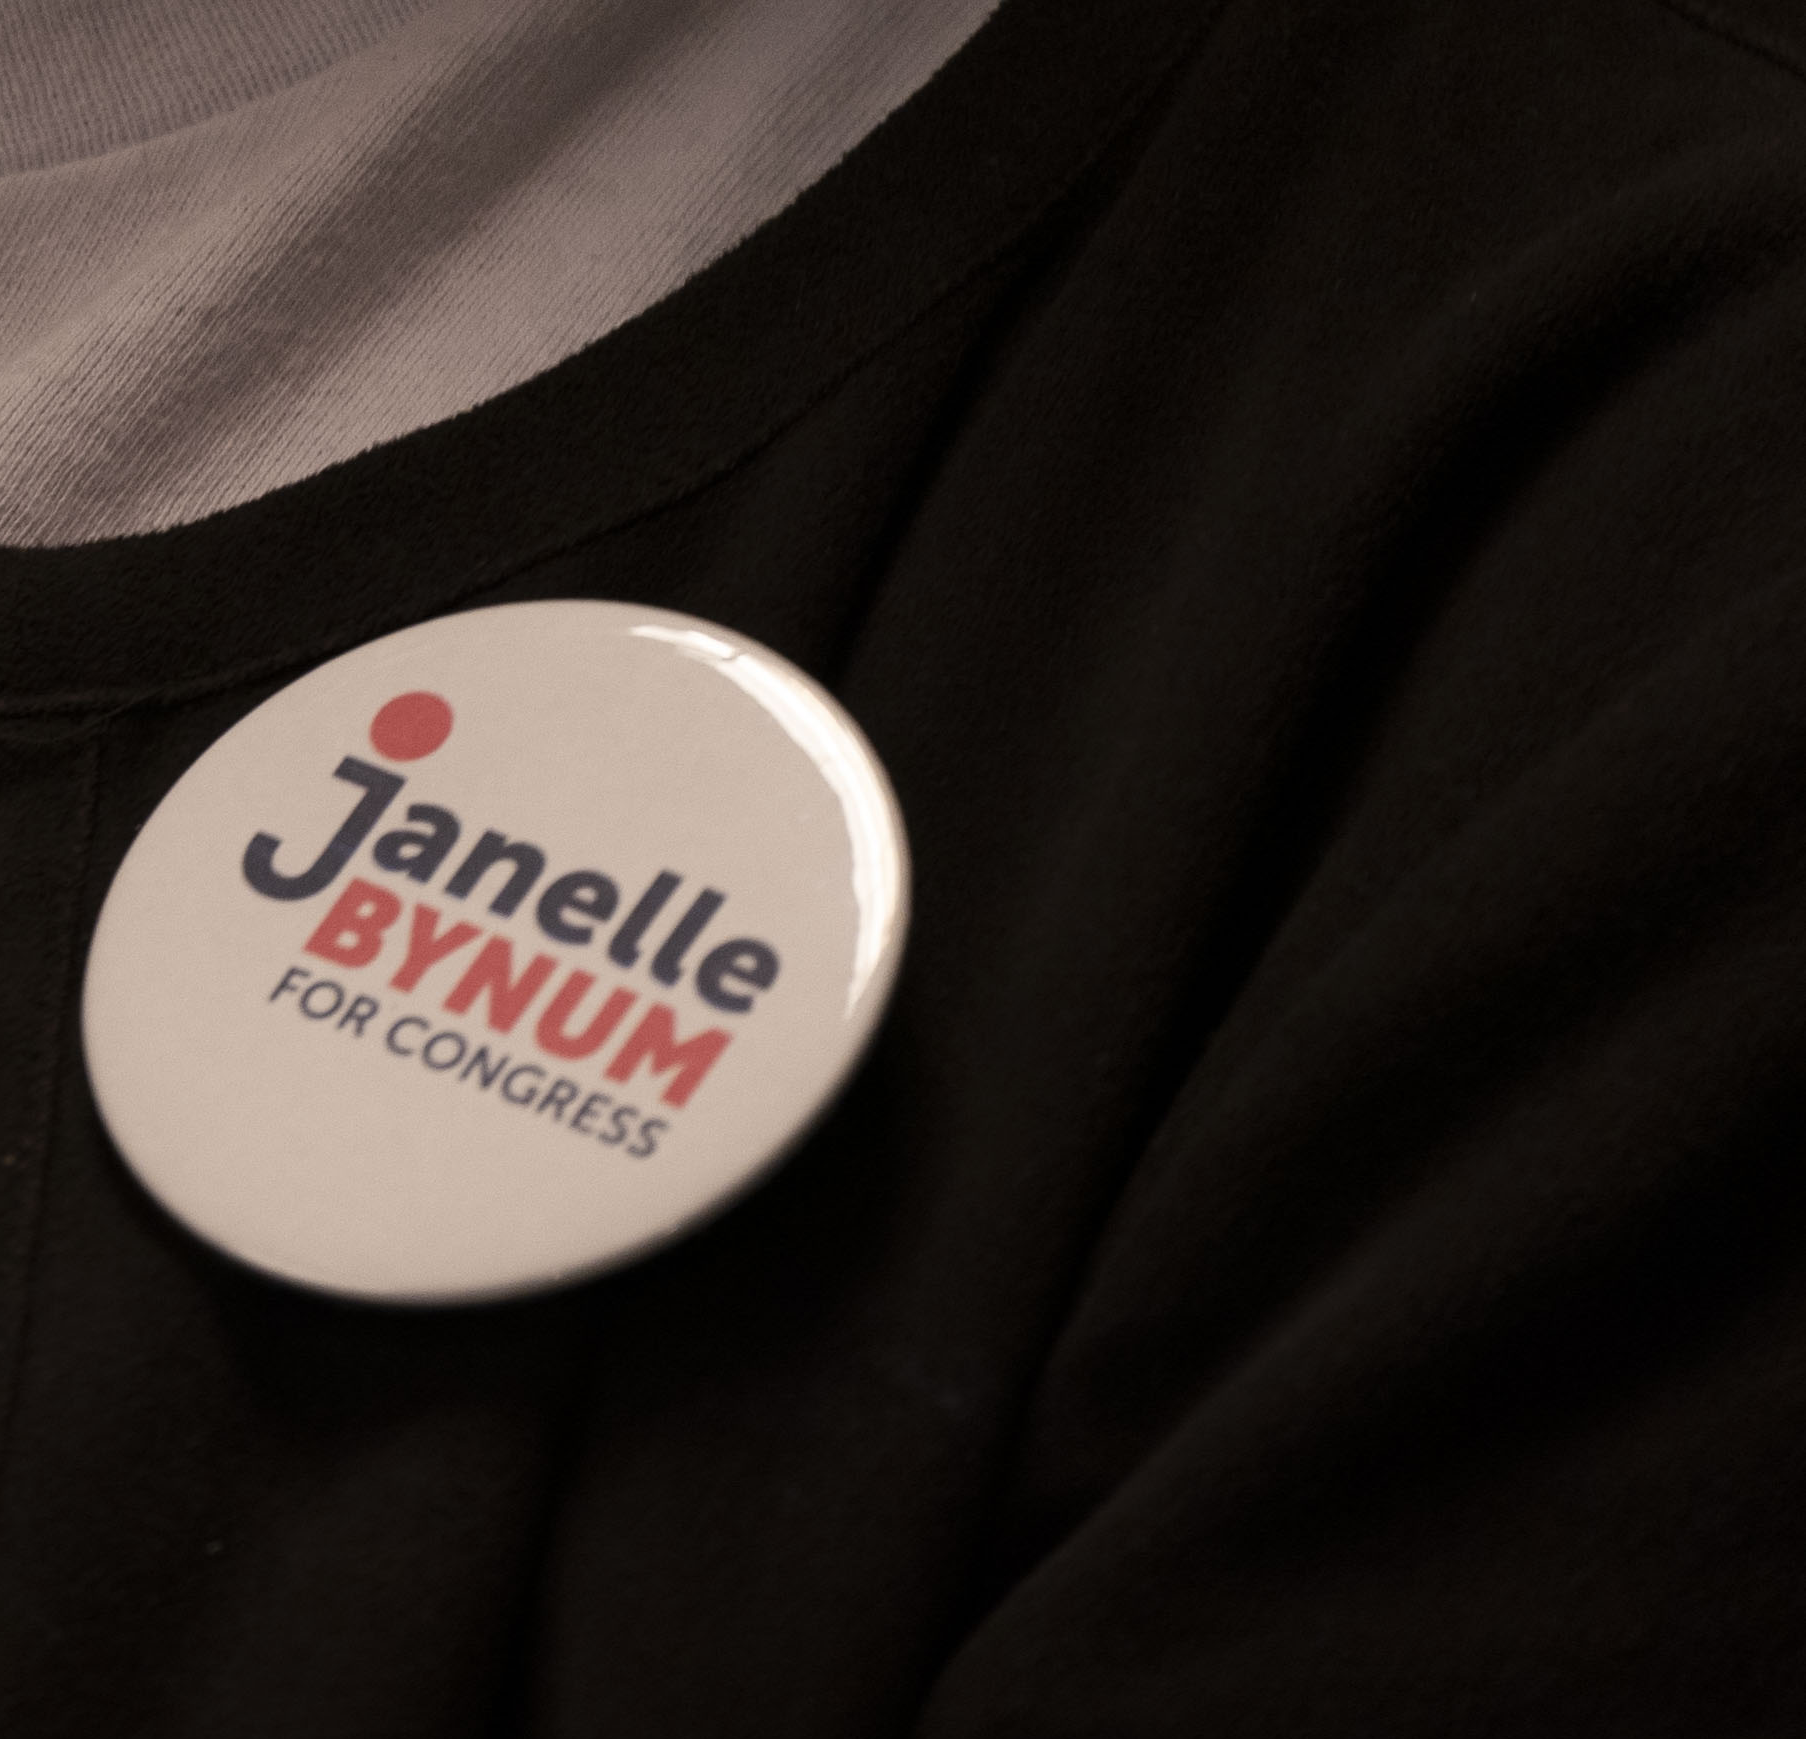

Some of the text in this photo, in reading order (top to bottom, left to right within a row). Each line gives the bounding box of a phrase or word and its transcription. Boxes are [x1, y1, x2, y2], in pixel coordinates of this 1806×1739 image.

[268, 966, 671, 1161] FOR CONGRESS
[302, 876, 736, 1112] BYNUM
